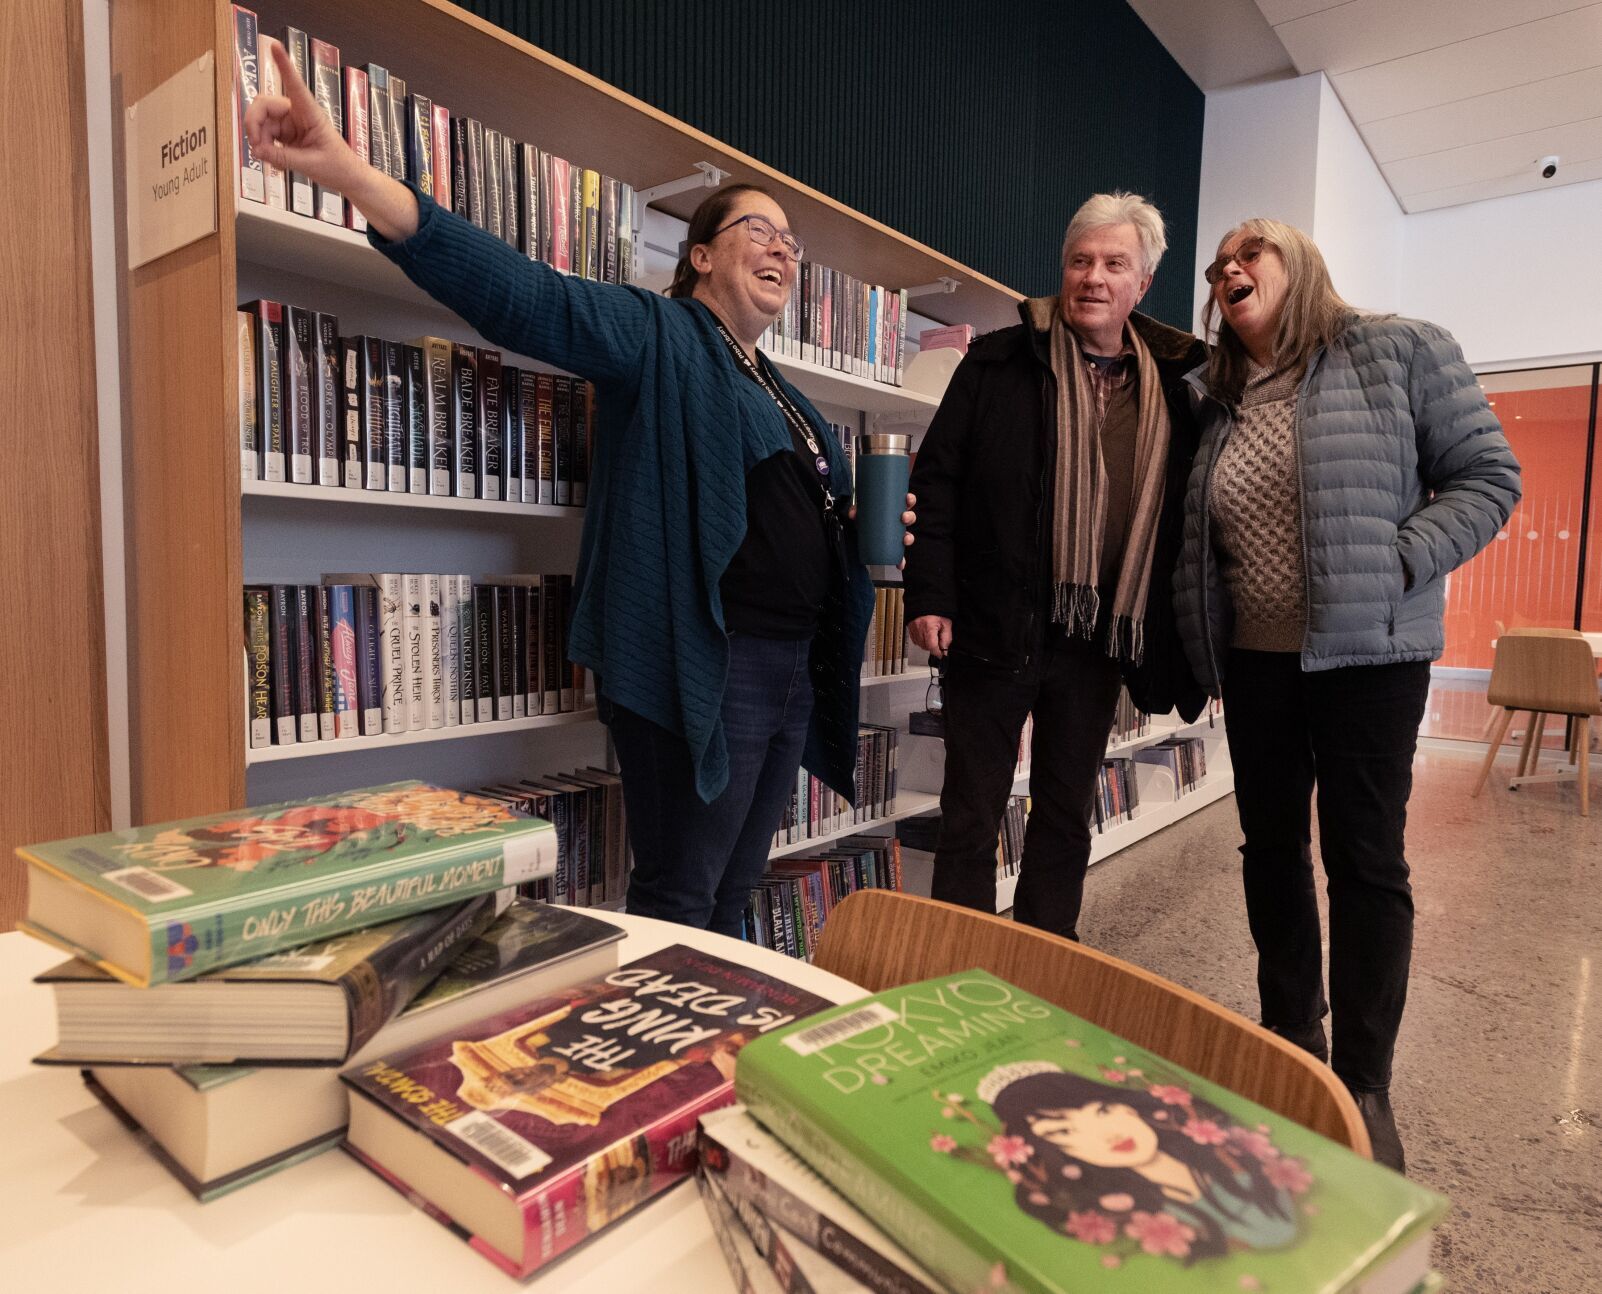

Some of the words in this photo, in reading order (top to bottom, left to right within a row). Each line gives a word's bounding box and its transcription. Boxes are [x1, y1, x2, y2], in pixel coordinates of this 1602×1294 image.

[243, 48, 257, 83] ACE
[161, 126, 206, 169] Fiction
[152, 175, 180, 202] Young
[183, 157, 208, 186] Adult
[606, 219, 615, 282] FLEDGLIN
[717, 326, 734, 347] Library
[732, 344, 745, 360] Ptbo
[389, 347, 397, 367] ASTER
[270, 359, 280, 409] DAUGHTER
[431, 357, 447, 405] REALM
[460, 367, 473, 408] BLADE
[485, 376, 500, 408] FATE
[749, 366, 767, 387] Library
[300, 385, 309, 419] BLOOD
[538, 398, 552, 416] THE
[432, 411, 448, 470] BREAKER
[459, 410, 474, 473] BREAKER
[484, 410, 499, 470] BREAKER
[538, 418, 552, 445] FINAL
[279, 590, 287, 616] BAYRON
[256, 624, 264, 642] THIS
[336, 621, 355, 665] Always
[389, 628, 401, 664] CRUEL
[448, 626, 458, 661] QUEEN
[463, 625, 472, 668] WICKED
[480, 612, 488, 664] CHAMPION
[501, 609, 509, 649] WARRIOR
[253, 645, 267, 687] POISON
[408, 631, 421, 674] STOLEN
[431, 627, 440, 676] PRISONER'S
[340, 668, 357, 702] Jane
[387, 665, 403, 706] PRINCE
[412, 677, 422, 703] HEIR
[430, 677, 442, 704] THRON
[448, 667, 458, 703] NOTHIN
[460, 668, 473, 697] KING
[255, 690, 268, 720] HEAR
[577, 822, 586, 890] SEASPARRO
[242, 907, 299, 941] ONLY
[303, 892, 348, 926] THIS
[346, 873, 437, 918] BEAUTIFUL
[438, 855, 505, 892] MOMENT
[795, 907, 803, 940] CONTRARY
[420, 957, 427, 972] A
[604, 968, 748, 1016] DEAD
[580, 997, 722, 1055] KING
[736, 1006, 797, 1033] IS
[815, 977, 1013, 1066] OKYO
[552, 1034, 637, 1072] THE
[822, 999, 1051, 1094] DREAMING
[918, 1048, 979, 1078] EMIKO
[431, 1097, 464, 1127] THE
